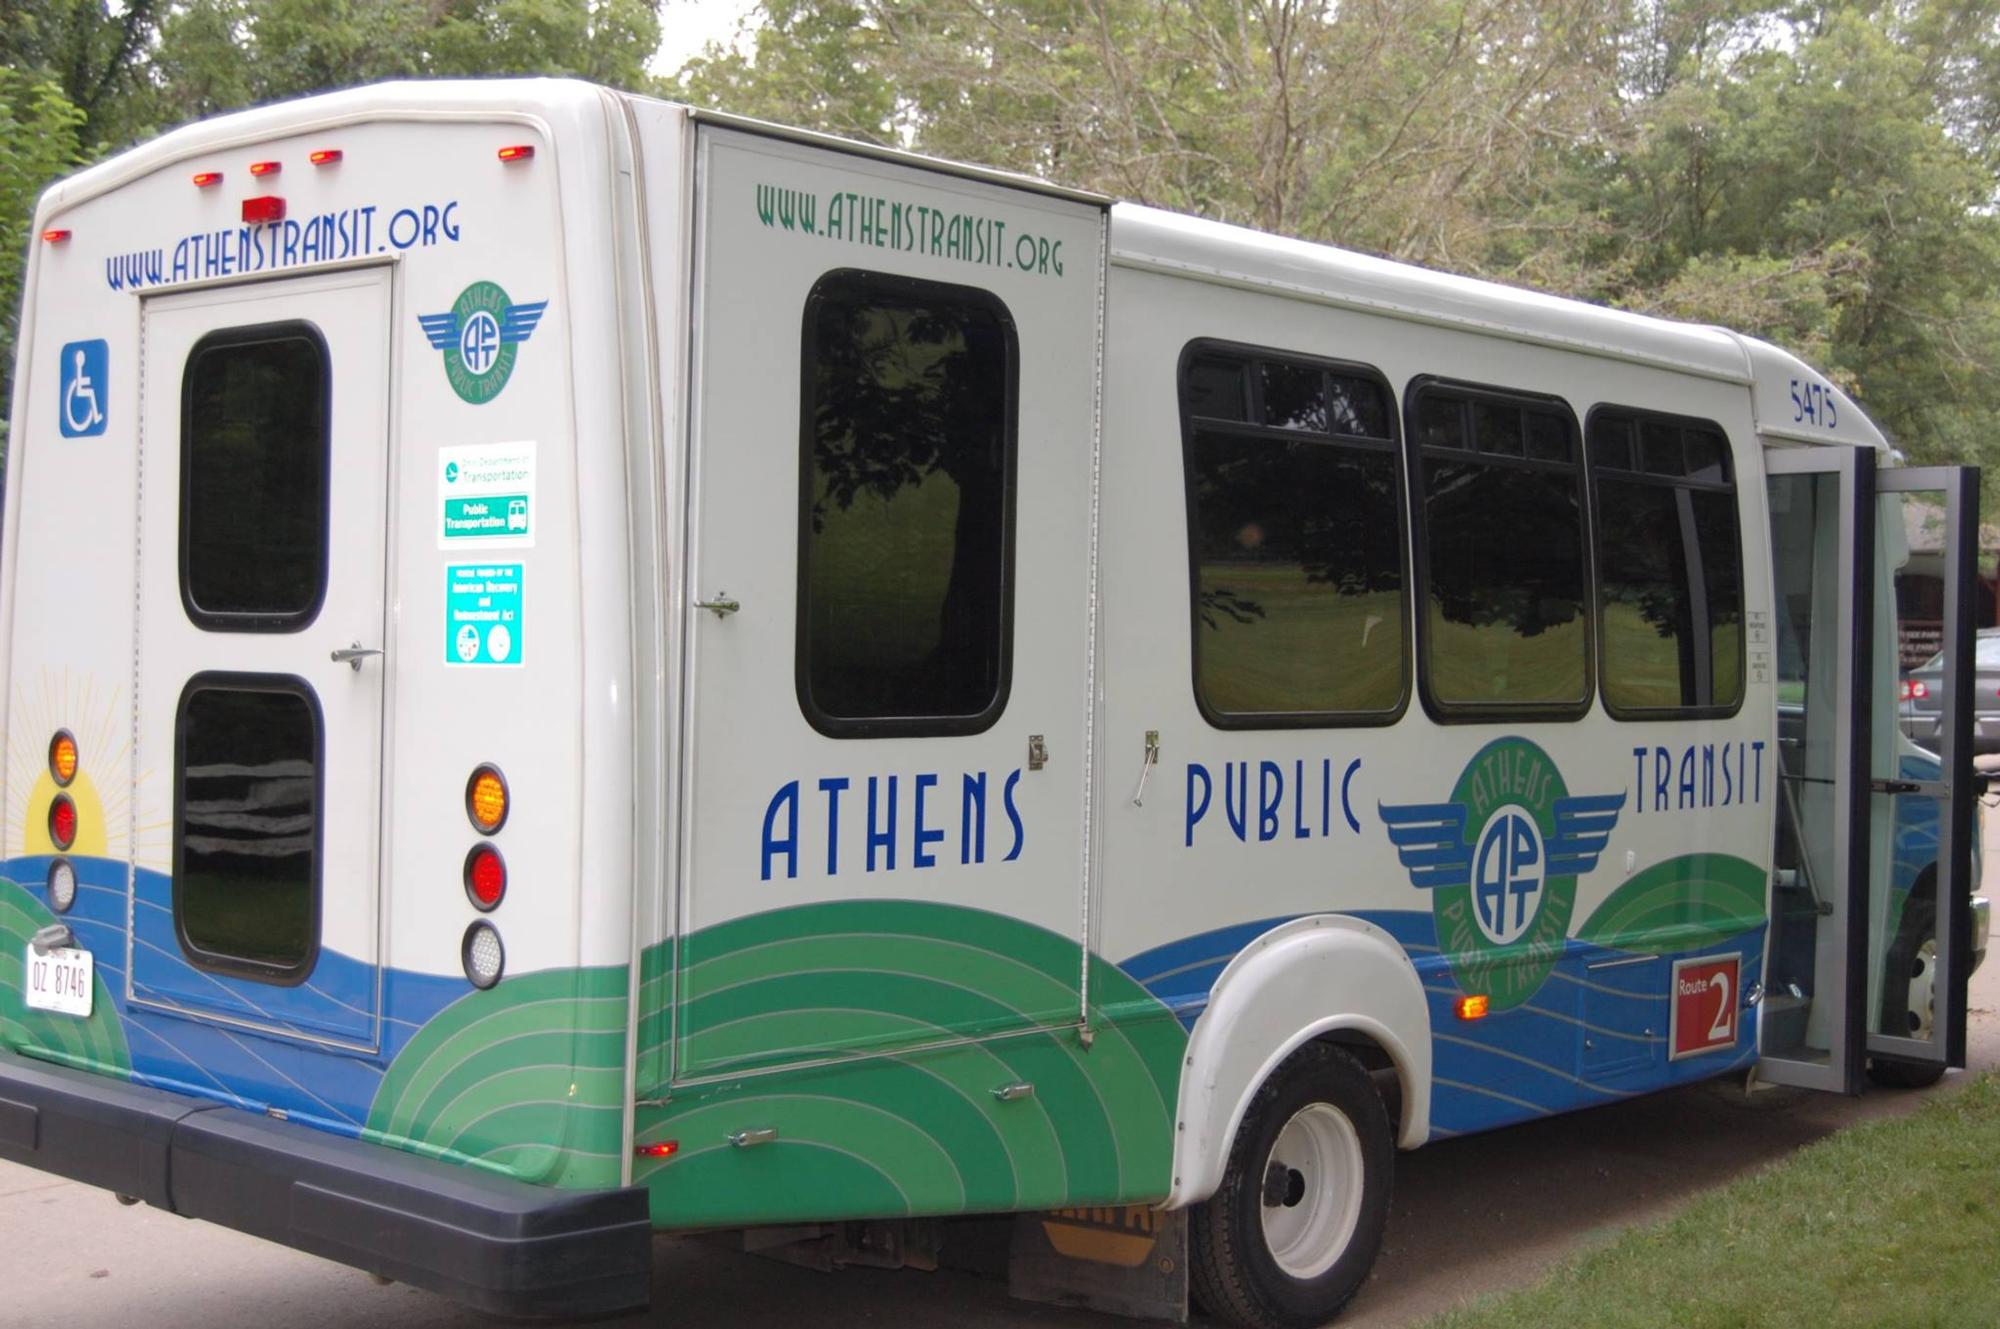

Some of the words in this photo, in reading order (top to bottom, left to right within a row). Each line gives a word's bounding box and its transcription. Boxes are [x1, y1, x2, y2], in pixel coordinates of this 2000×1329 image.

[106, 201, 460, 291] WWW.ATHENSTRANSIT.ORG
[756, 183, 1063, 278] WWW.ATHENSTRANSIT.ORG
[1790, 378, 1838, 429] 5475
[463, 470, 529, 483] Transportation
[463, 503, 488, 516] Public
[446, 517, 506, 530] Transportation
[760, 768, 1024, 881] ATHENS
[1185, 758, 1361, 848] PUBLIC
[1633, 741, 1765, 813] TRANSIT
[1471, 749, 1552, 816] ATHENS
[1442, 897, 1493, 995] PUBLIC
[1506, 889, 1568, 995] TRANSIT
[55, 965, 85, 999] 8746
[1679, 979, 1708, 995] Route
[1708, 971, 1732, 1041] 2
